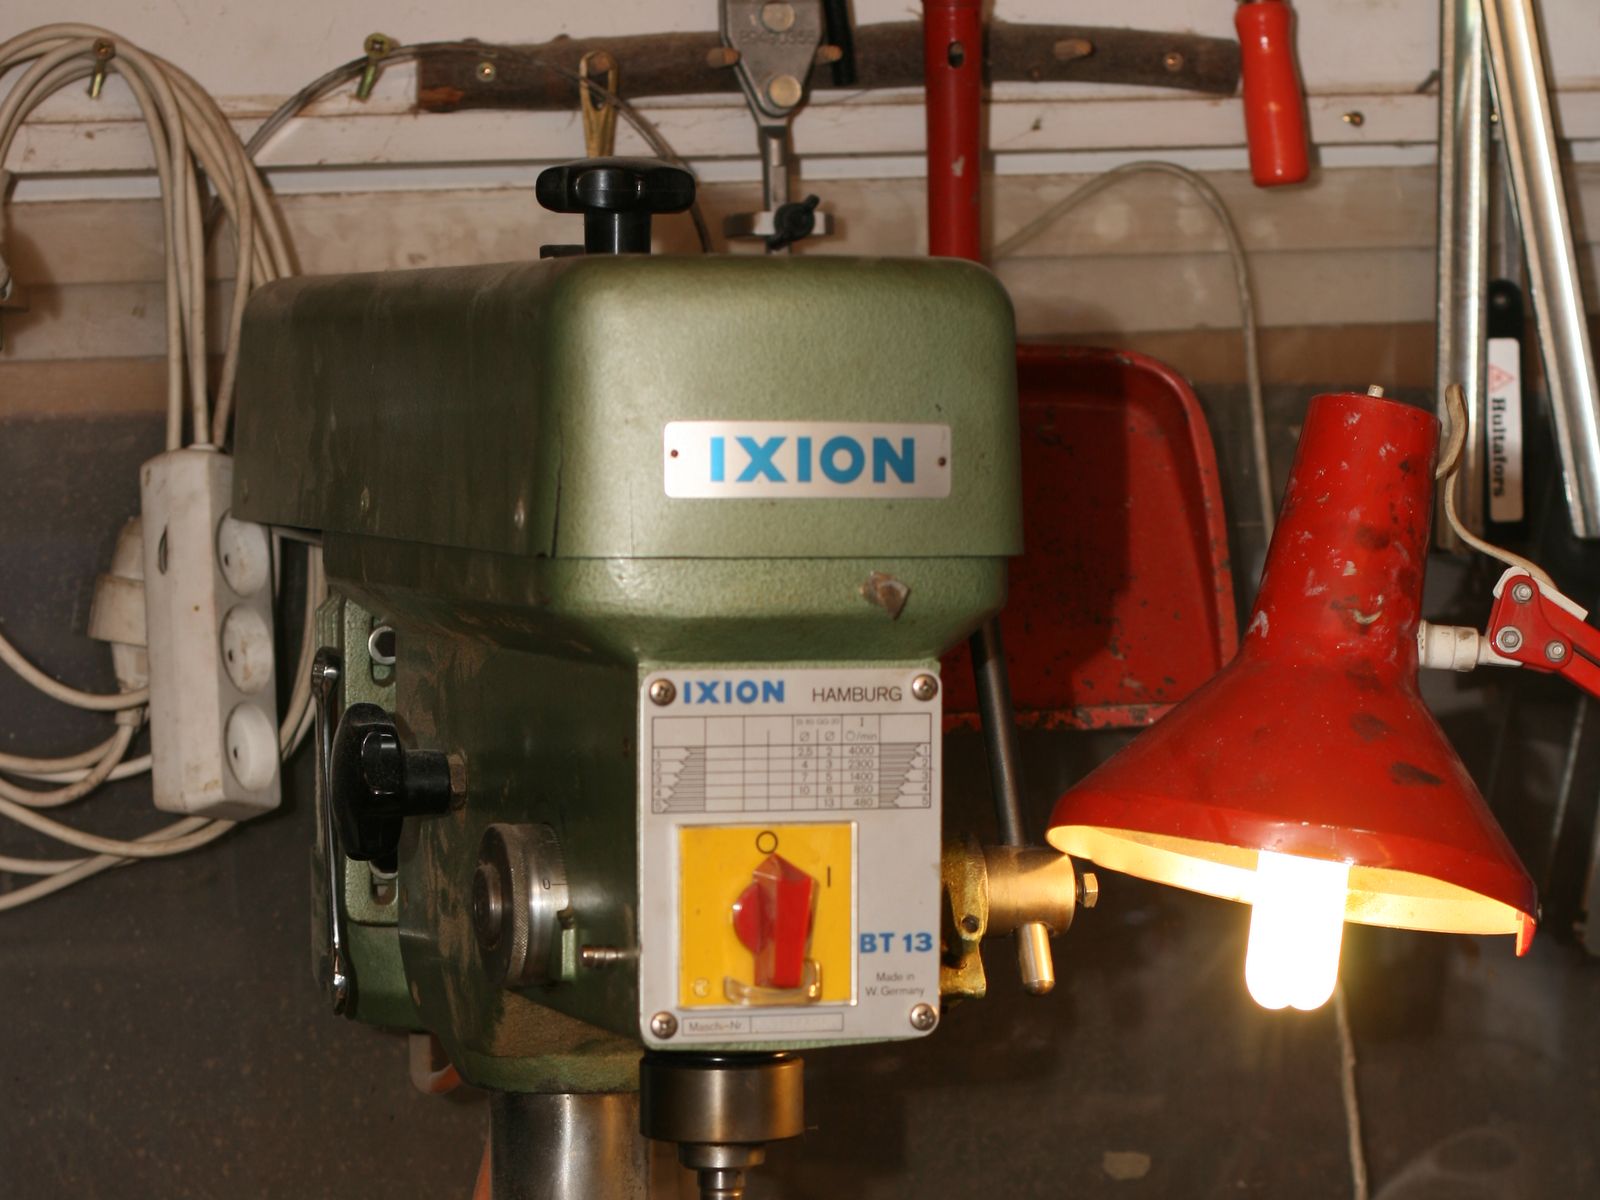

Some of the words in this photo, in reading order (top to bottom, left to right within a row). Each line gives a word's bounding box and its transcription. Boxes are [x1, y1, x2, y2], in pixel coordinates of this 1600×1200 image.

[1491, 397, 1507, 498] Hultafors
[710, 436, 915, 484] IXION
[683, 680, 785, 704] IXION
[812, 686, 902, 702] HAMBURG
[848, 744, 875, 755] 4000
[801, 760, 808, 769] 4
[847, 759, 874, 769] 2300
[850, 771, 874, 781] 1400
[853, 784, 874, 794] 850
[860, 932, 895, 953] BT
[902, 932, 933, 952] 13
[876, 972, 903, 982] Made
[906, 972, 915, 981] in
[881, 986, 925, 997] Germany
